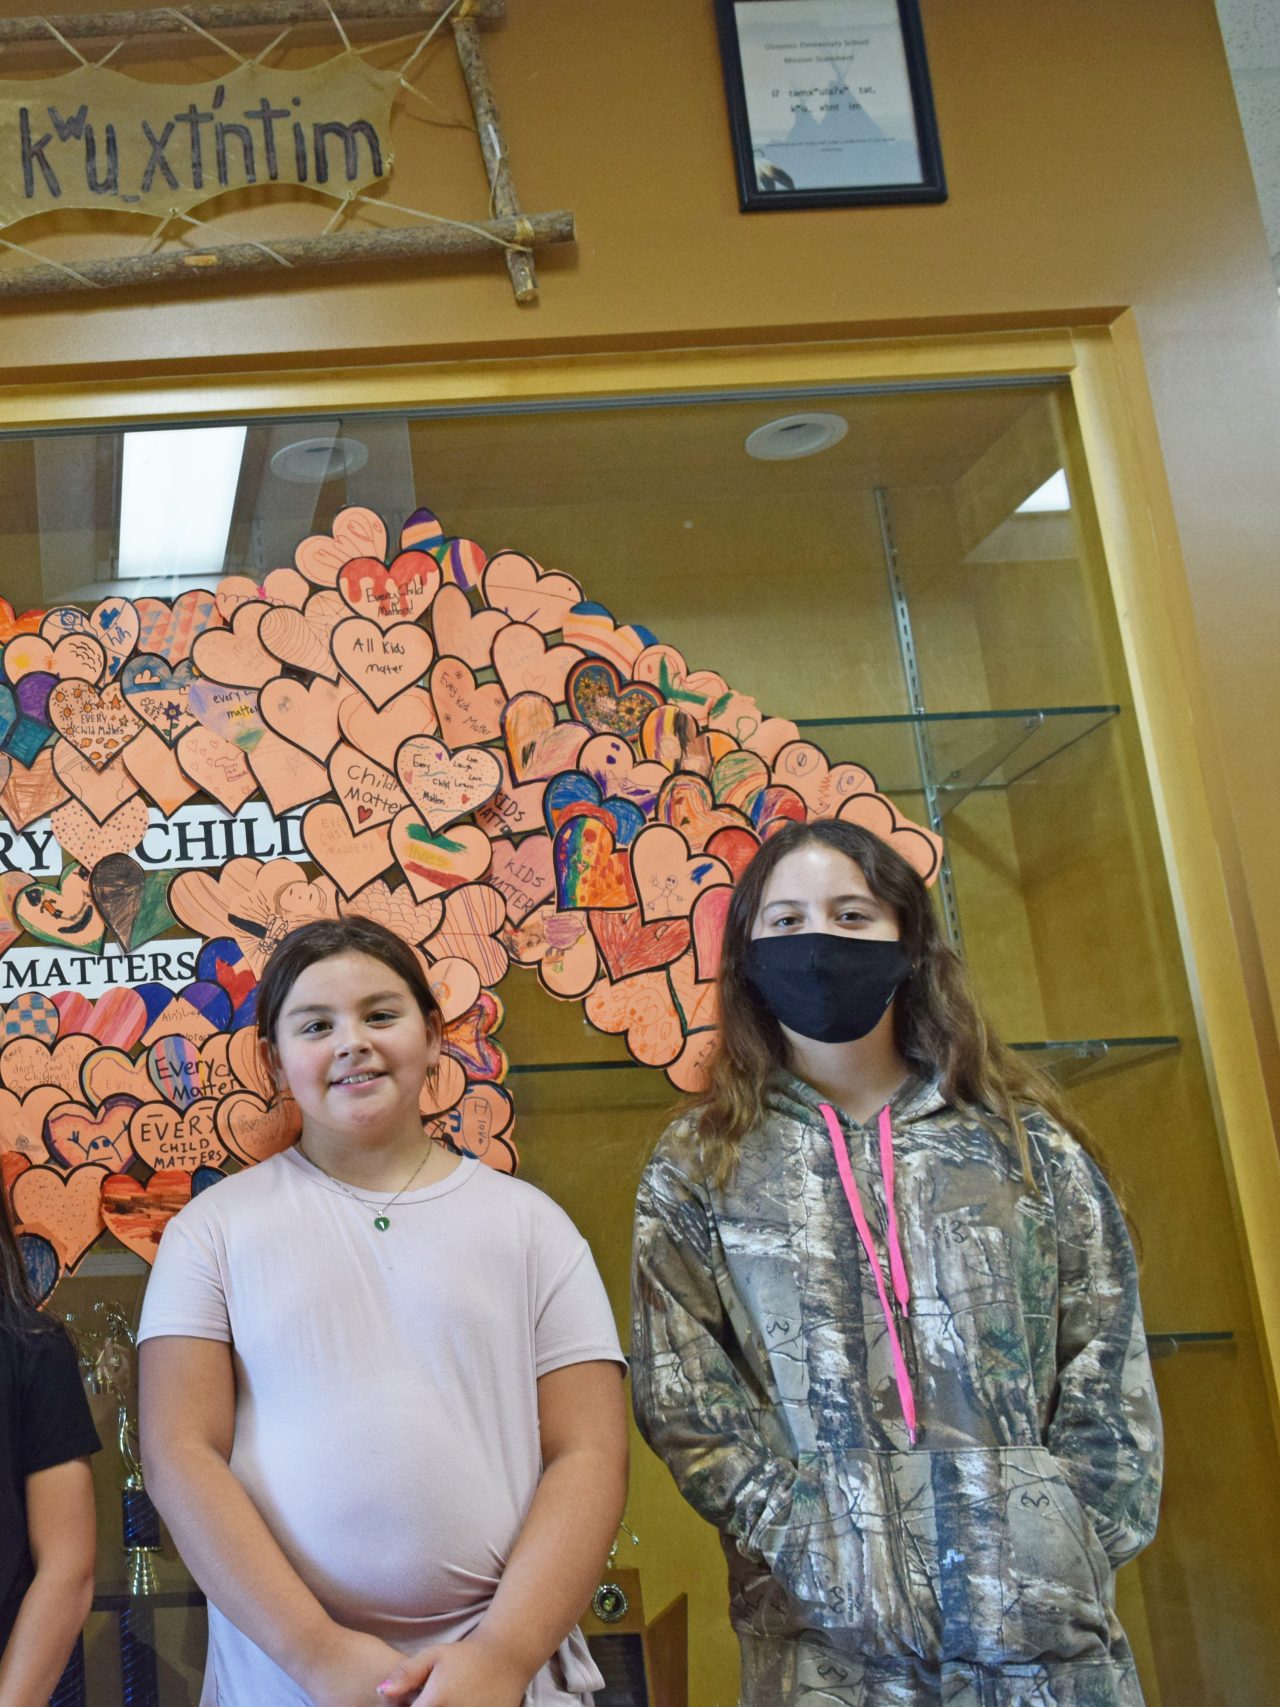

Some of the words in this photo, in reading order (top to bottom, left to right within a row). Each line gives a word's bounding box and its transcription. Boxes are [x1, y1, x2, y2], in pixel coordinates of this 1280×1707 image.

[353, 637, 374, 652] All
[382, 641, 406, 655] Kids
[213, 690, 241, 704] every
[80, 713, 108, 724] EVERY
[347, 764, 405, 795] Childr
[133, 814, 308, 866] CHILD
[504, 857, 546, 888] KIDS
[1, 950, 198, 990] MATTERS
[141, 1114, 215, 1144] EVERY
[159, 1137, 210, 1154] CHILD
[153, 1149, 222, 1169] MATTERS
